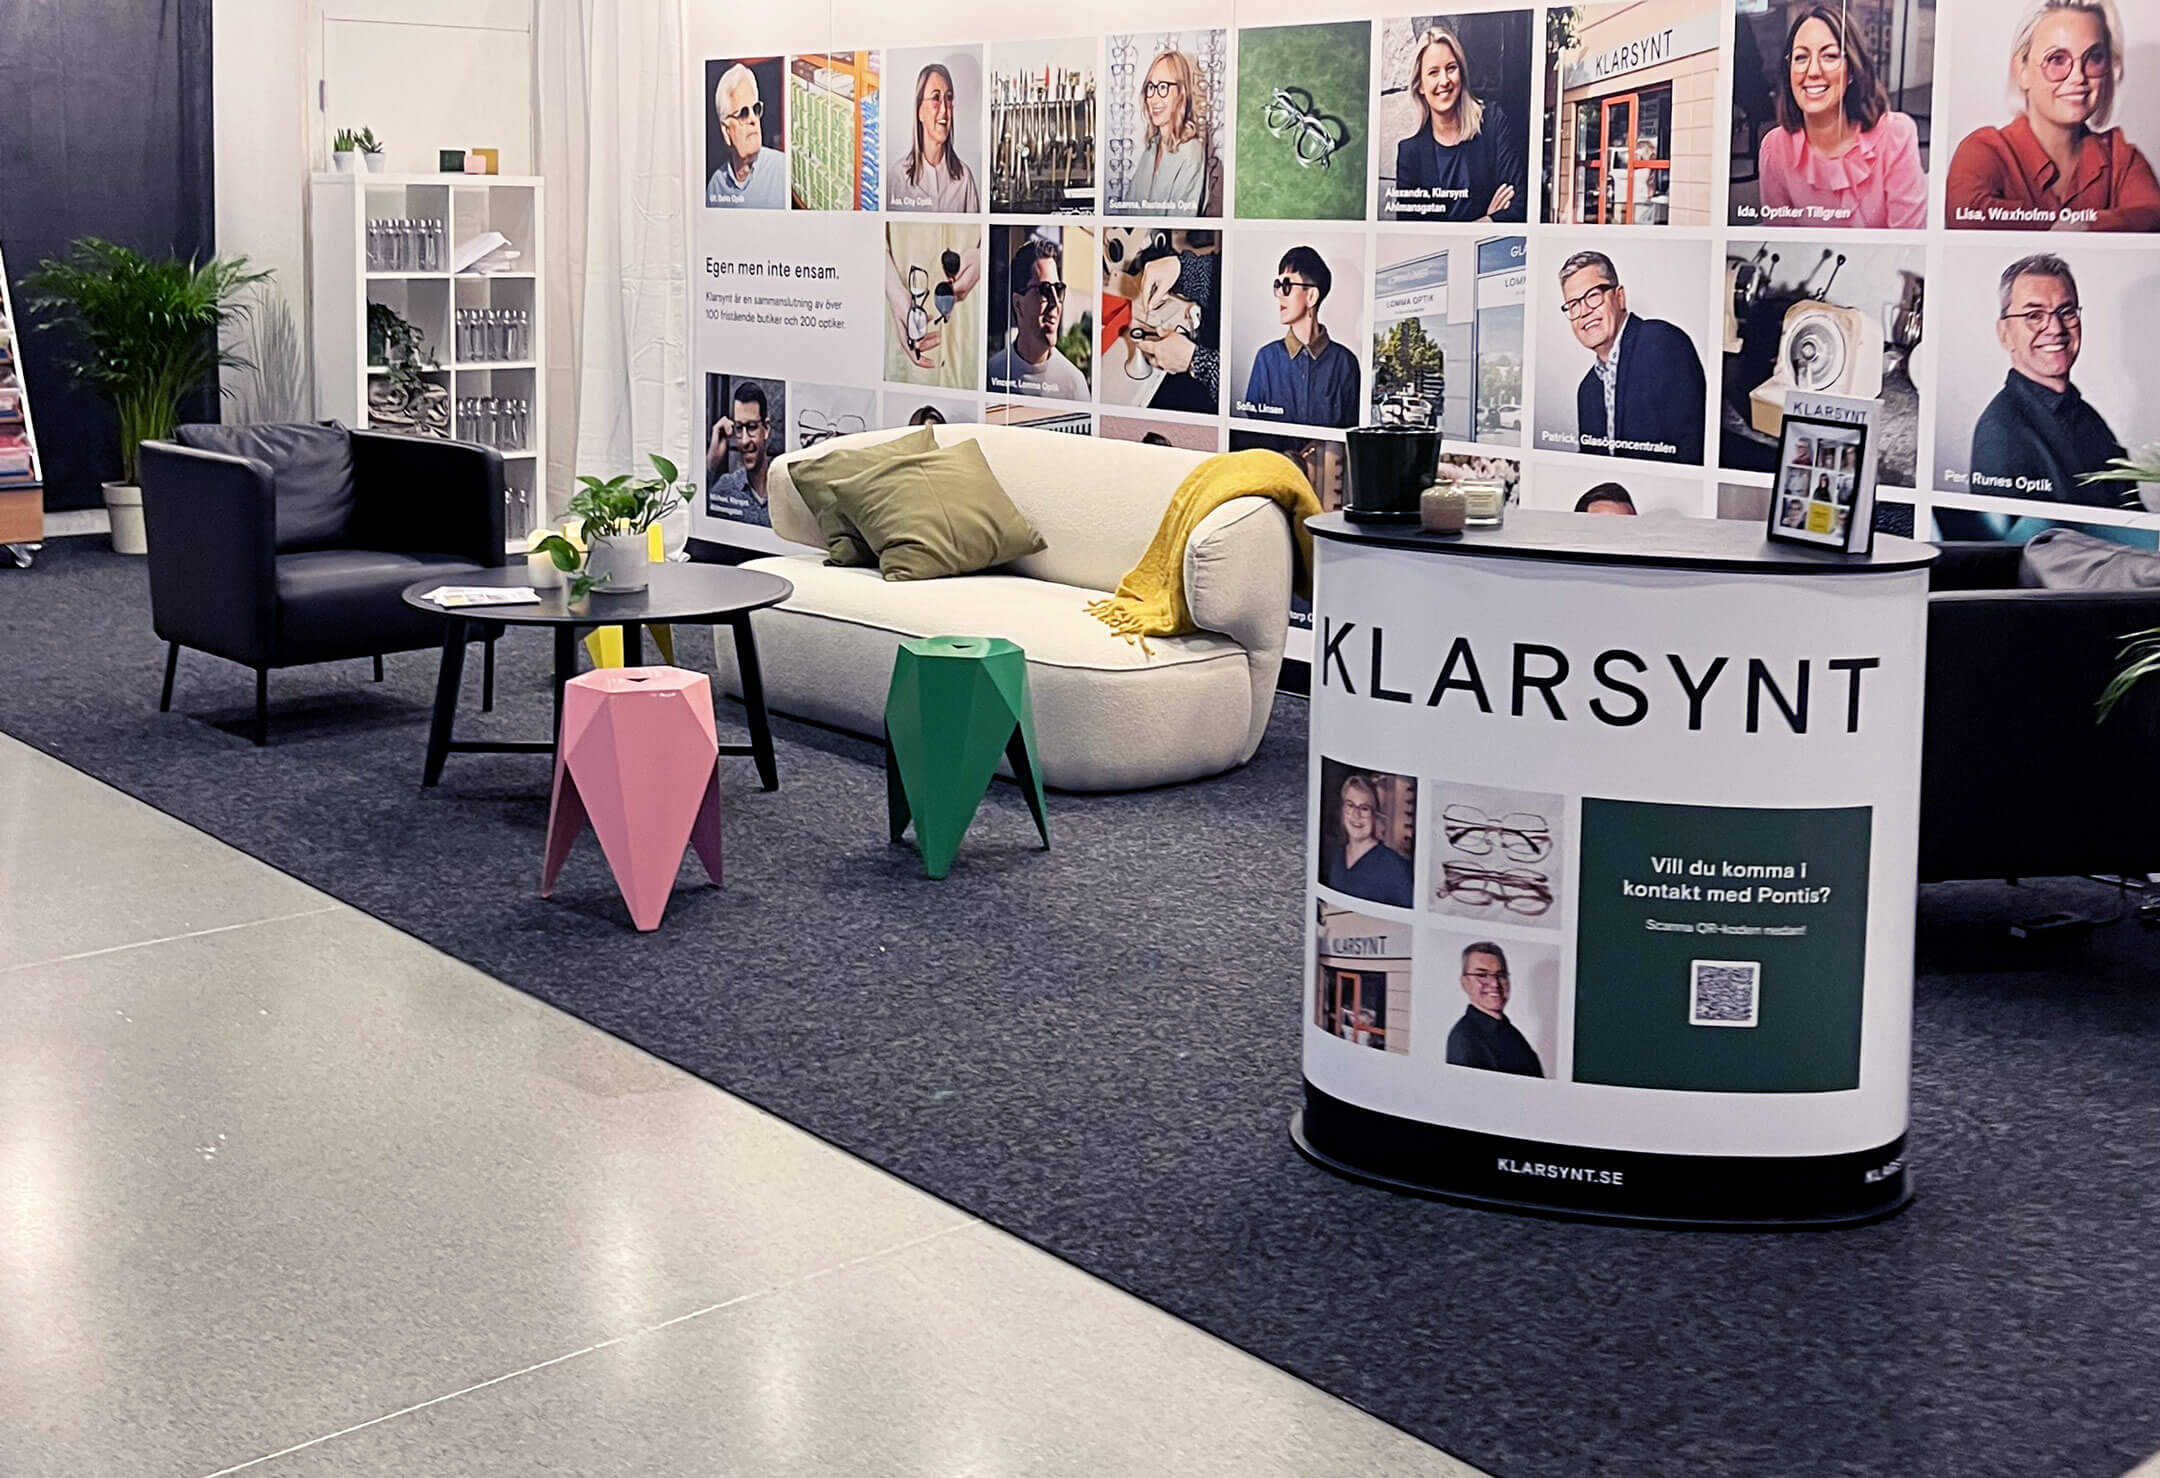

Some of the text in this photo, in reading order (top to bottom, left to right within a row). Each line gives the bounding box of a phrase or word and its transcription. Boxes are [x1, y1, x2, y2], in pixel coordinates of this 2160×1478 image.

[1596, 29, 1673, 77] KLARSYNT
[1385, 187, 1469, 201] Alexandra, Klarsynt
[1737, 205, 1852, 221] Ida, Optiker Tillgren
[1956, 207, 2098, 224] Lisa, Waxholms Optik
[706, 257, 840, 279] Egen men inte ensam.
[706, 292, 842, 311] Klarsynt är en sammanslutning av över
[1412, 294, 1433, 305] OPTIK
[705, 308, 719, 320] 100
[720, 310, 756, 323] fristående
[756, 313, 782, 325] butiker
[784, 316, 799, 326] och
[800, 316, 816, 328] 200
[1236, 401, 1257, 413] Sofia,
[1792, 401, 1867, 424] KLARSYNT
[1542, 430, 1677, 454] Patrick, Glasögoncentralen
[1972, 472, 2013, 488] Runes
[2015, 476, 2053, 493] Optik
[1323, 616, 1880, 735] KLARSYNT
[1651, 856, 1807, 879] Vill du komma i
[1623, 880, 1831, 904] kontakt med Pontis?
[1497, 1158, 1624, 1185] KLARSYNT.SE
